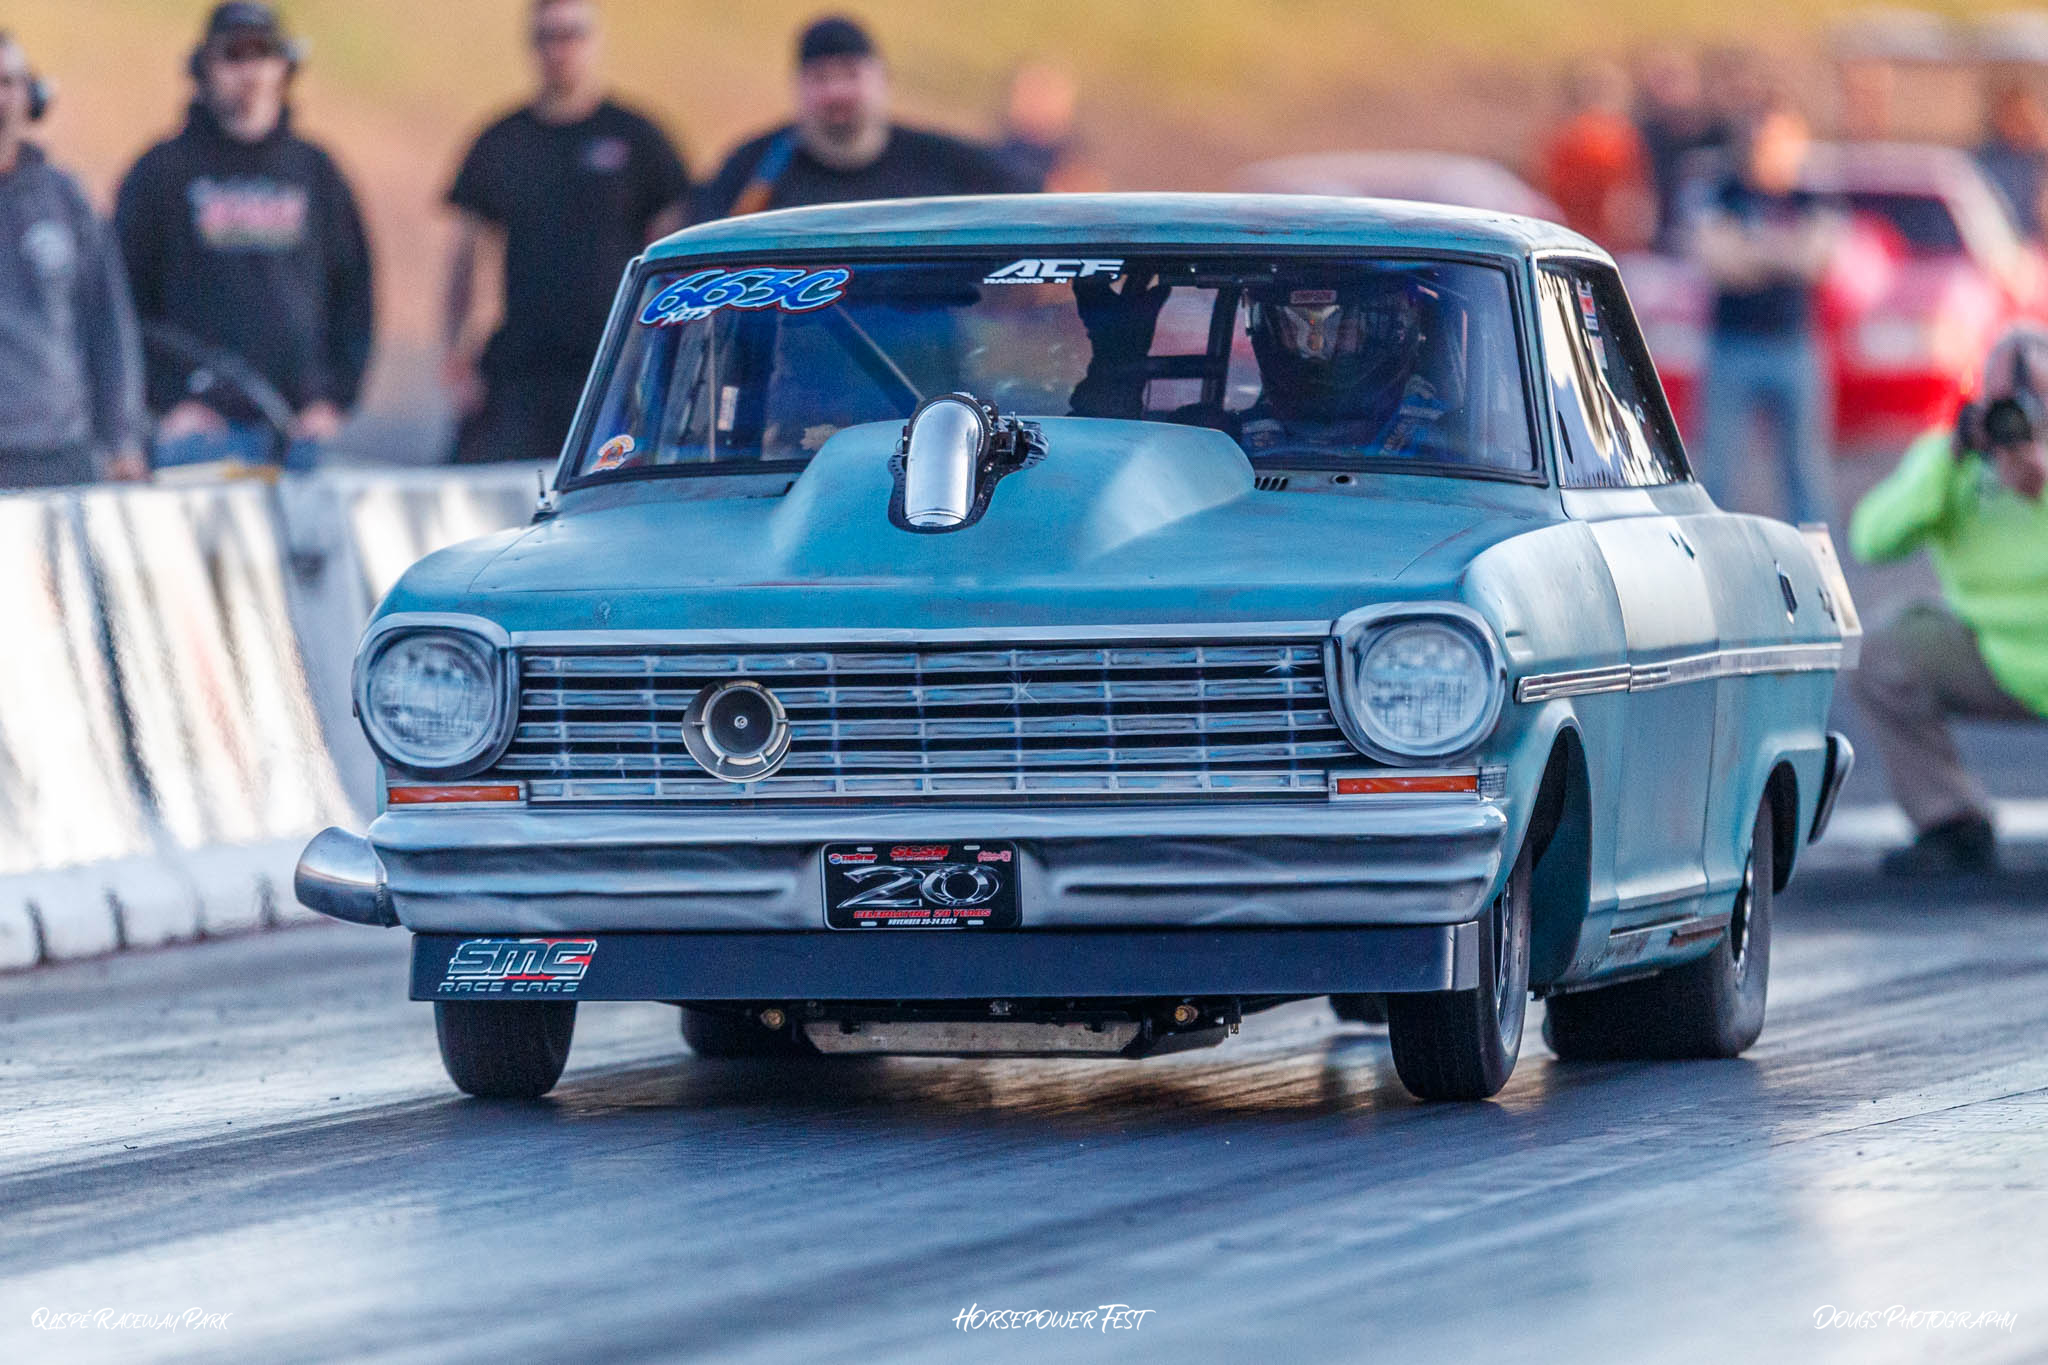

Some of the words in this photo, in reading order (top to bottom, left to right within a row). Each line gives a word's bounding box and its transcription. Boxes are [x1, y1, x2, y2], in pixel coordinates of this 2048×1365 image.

[988, 259, 1125, 277] ACF
[639, 267, 850, 325] 663C
[836, 864, 1000, 909] 20
[853, 910, 931, 919] CELEBRATING
[953, 909, 992, 918] YEARS
[887, 918, 921, 926] NOVEMBER
[447, 940, 597, 979] SMC
[437, 981, 506, 992] RACE
[511, 981, 579, 992] CARS
